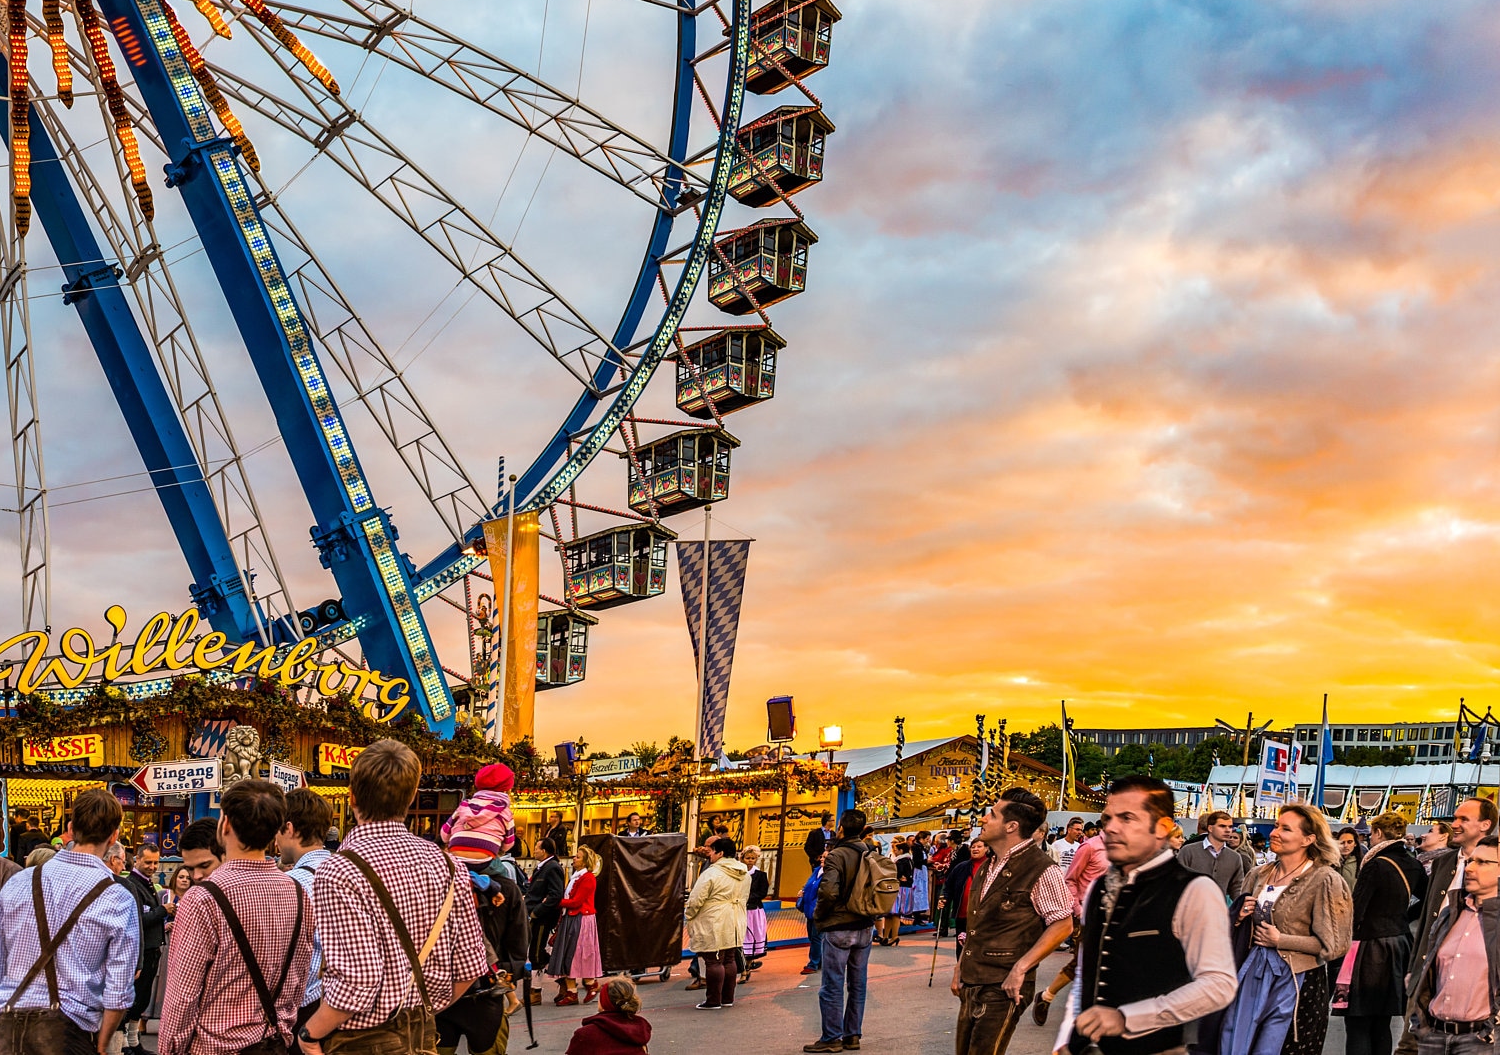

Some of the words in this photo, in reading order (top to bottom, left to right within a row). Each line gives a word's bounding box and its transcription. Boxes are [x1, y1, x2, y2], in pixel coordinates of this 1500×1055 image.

[29, 736, 96, 758] KASSE
[324, 745, 360, 765] KAS
[152, 765, 214, 782] Eingang
[274, 765, 298, 786] Eingang
[157, 782, 190, 791] Kasse
